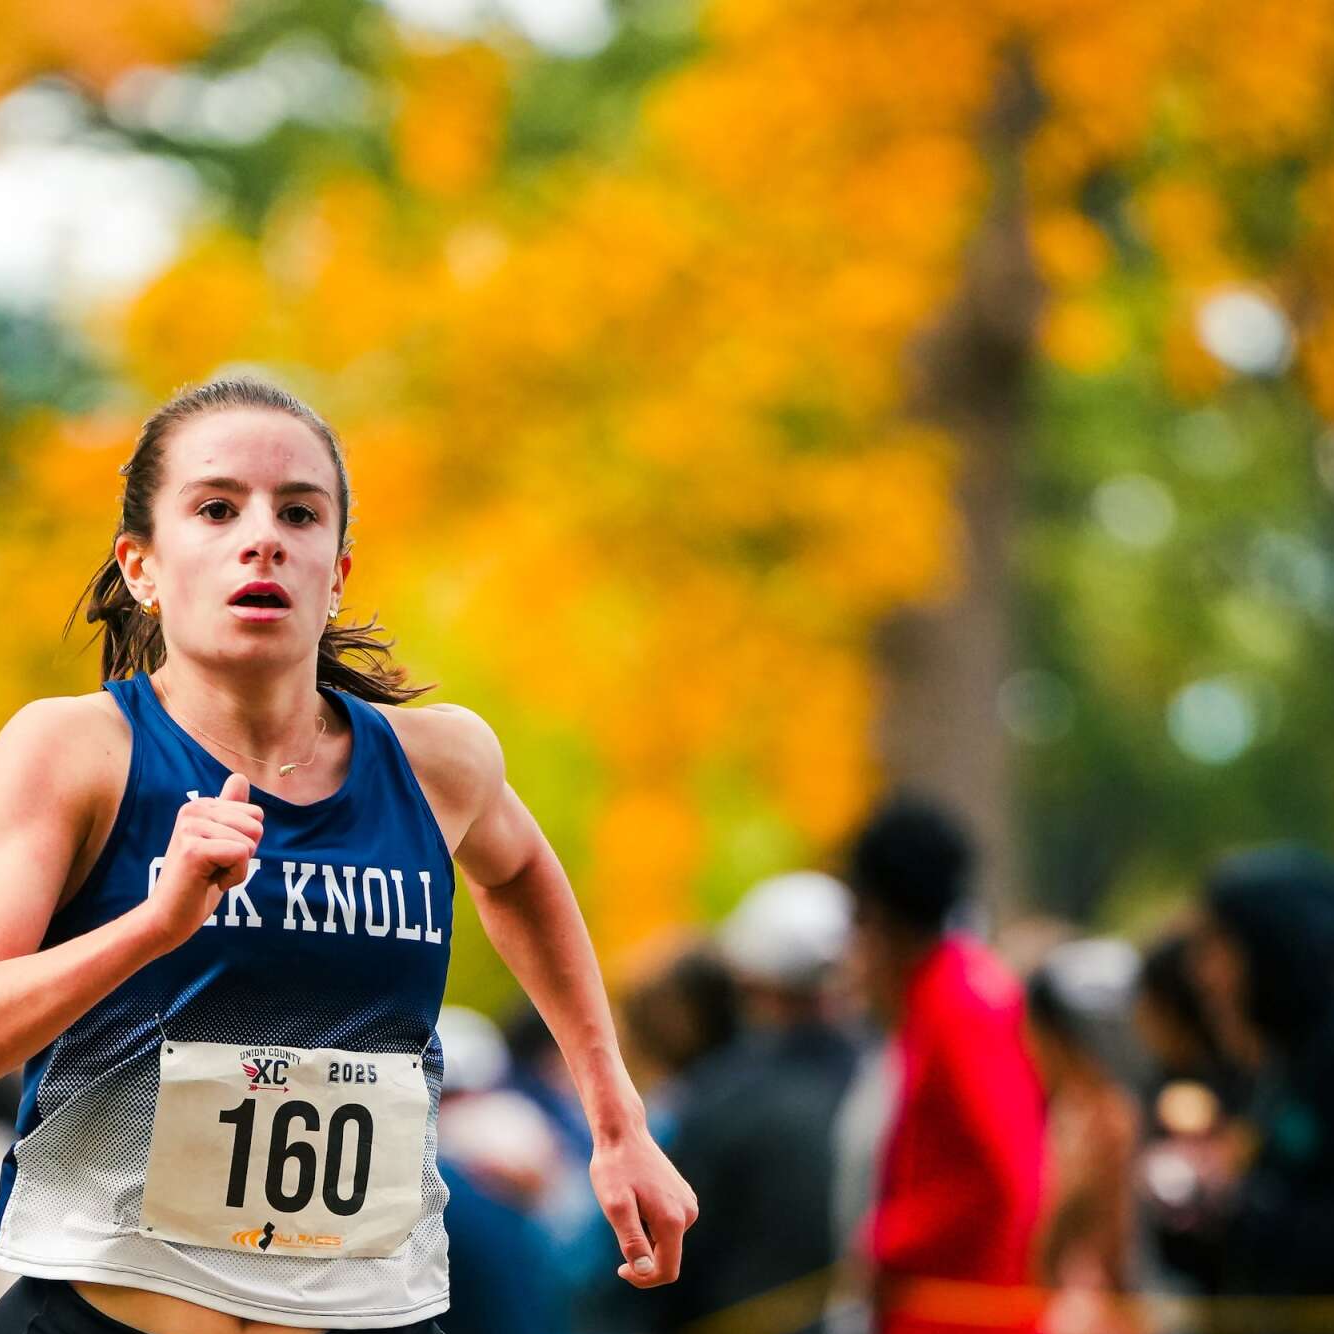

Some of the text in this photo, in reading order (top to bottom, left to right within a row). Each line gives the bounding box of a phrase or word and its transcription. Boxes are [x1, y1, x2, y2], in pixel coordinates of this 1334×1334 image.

[282, 861, 442, 945] KNOLL
[239, 1047, 302, 1065] UNION COUNTY
[251, 1058, 289, 1085] XC
[328, 1062, 377, 1084] 2025
[219, 1098, 374, 1216] 160
